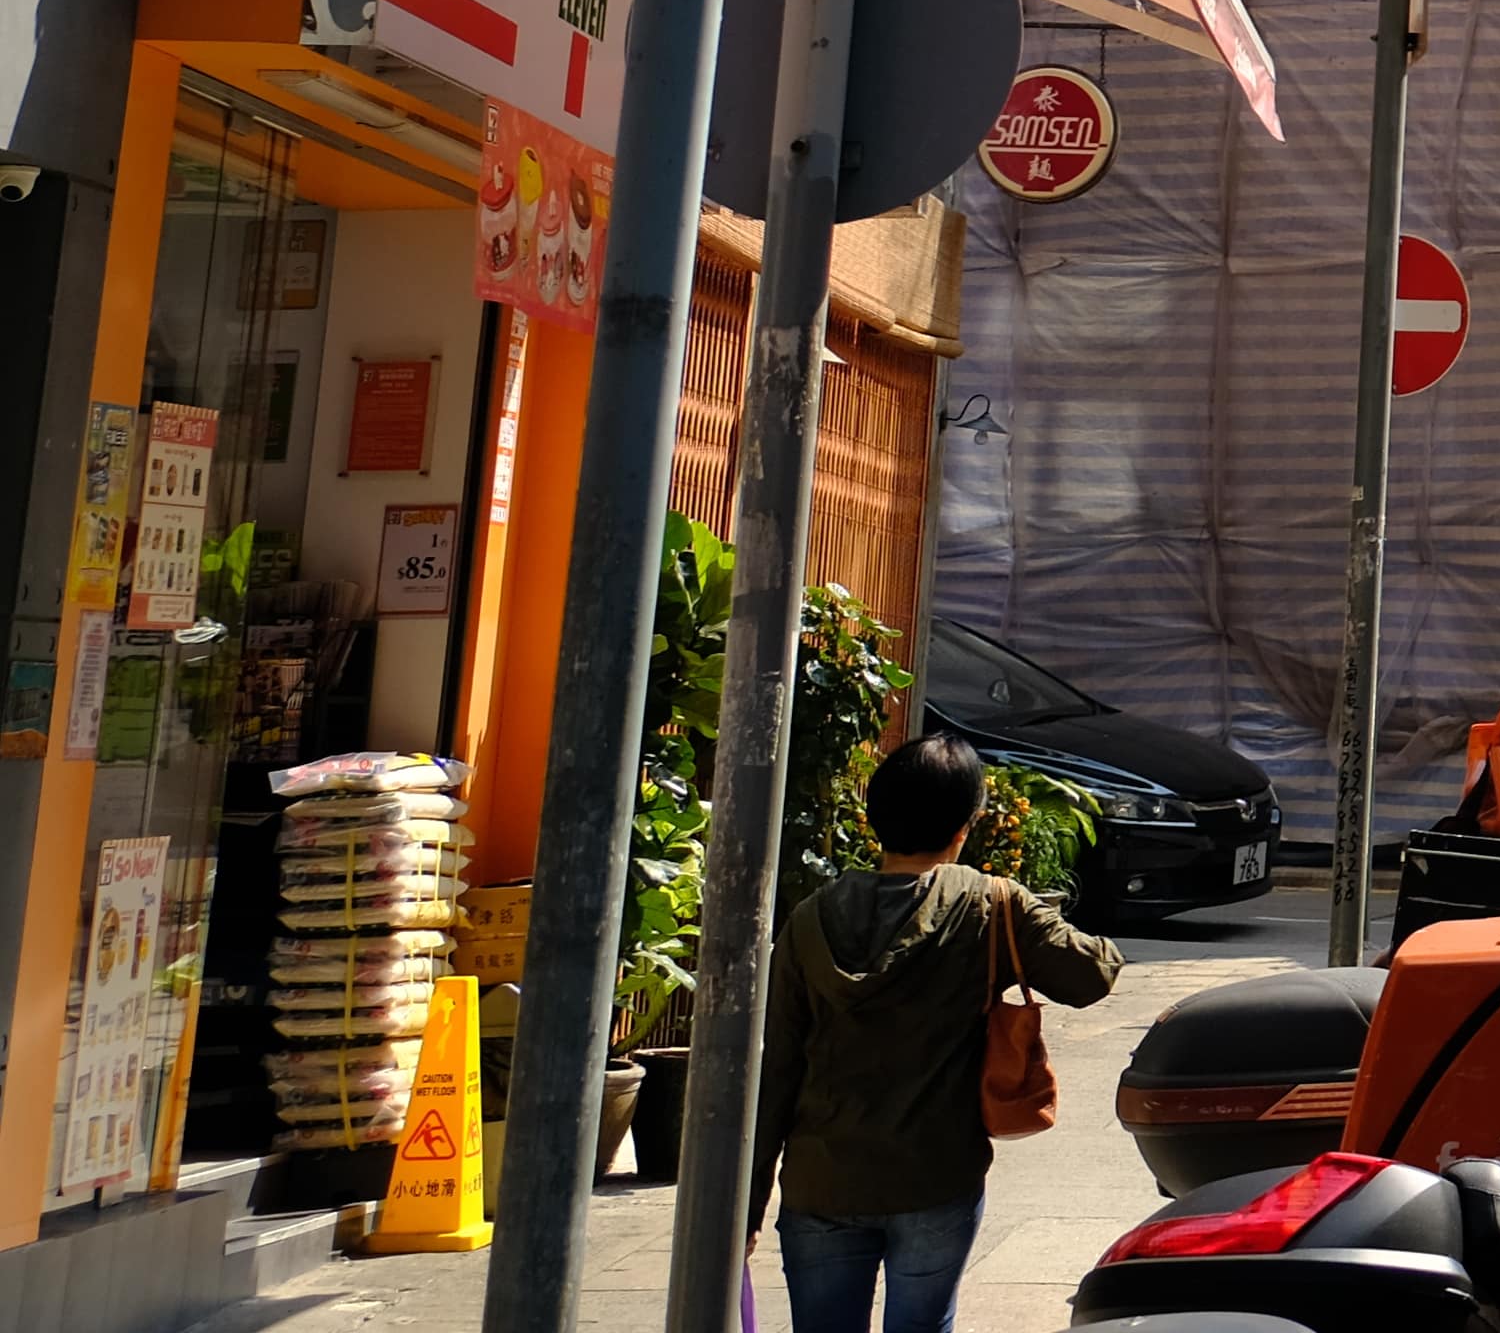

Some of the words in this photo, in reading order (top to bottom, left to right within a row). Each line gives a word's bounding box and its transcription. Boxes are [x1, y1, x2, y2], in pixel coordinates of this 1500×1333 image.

[990, 115, 1101, 149] SAMSEN
[422, 1073, 454, 1083] CAUTION
[415, 1086, 433, 1097] WET
[392, 1178, 457, 1199] 小心地滑
